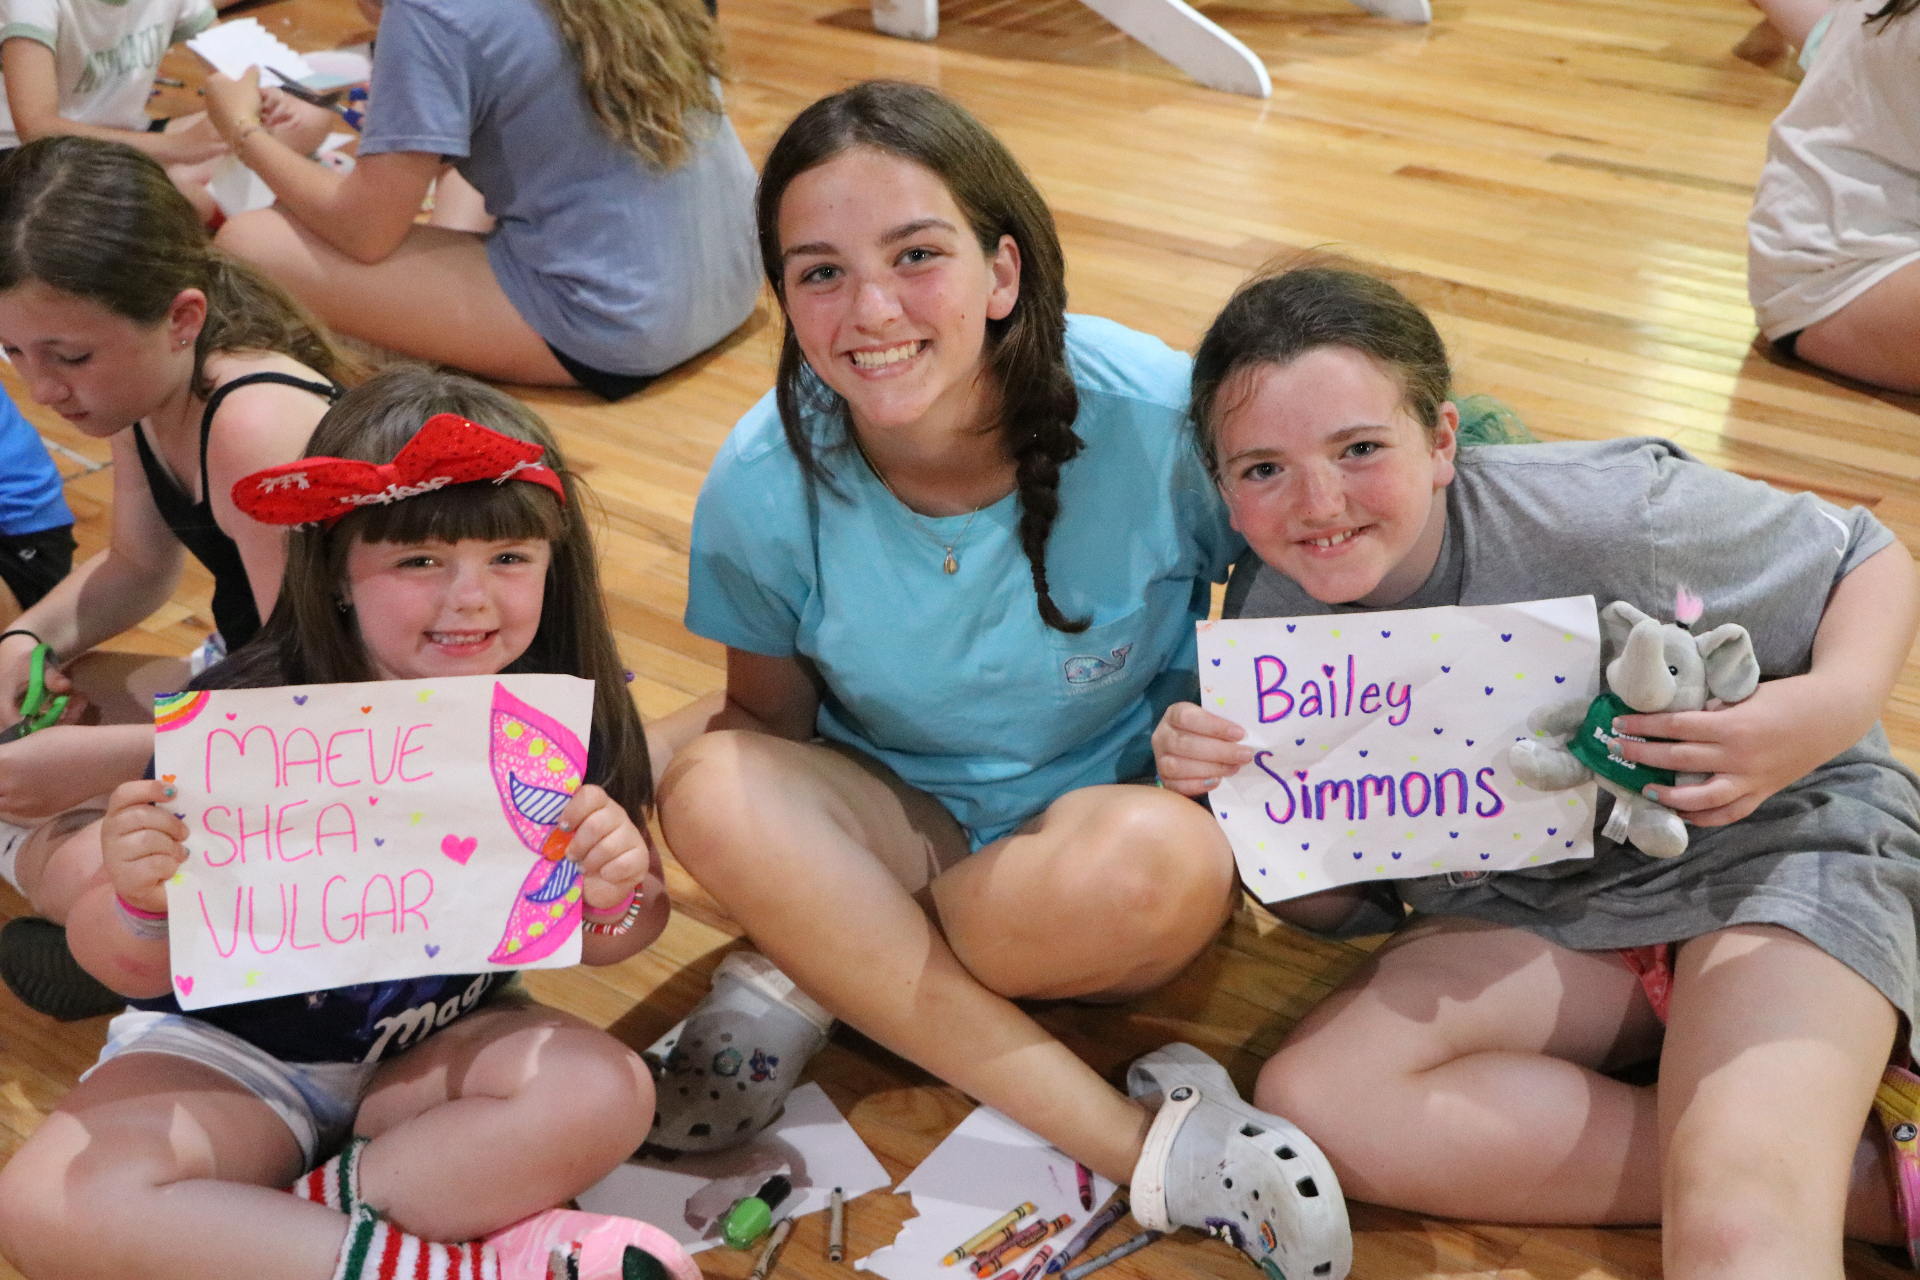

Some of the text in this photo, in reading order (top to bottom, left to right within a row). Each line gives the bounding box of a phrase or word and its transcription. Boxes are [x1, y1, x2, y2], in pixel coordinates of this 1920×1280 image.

[1253, 654, 1412, 727] Bailey
[204, 723, 435, 795] MAEVE
[1253, 750, 1506, 826] Simmons
[202, 798, 358, 868] SHEA
[197, 867, 435, 959] VULGAR
